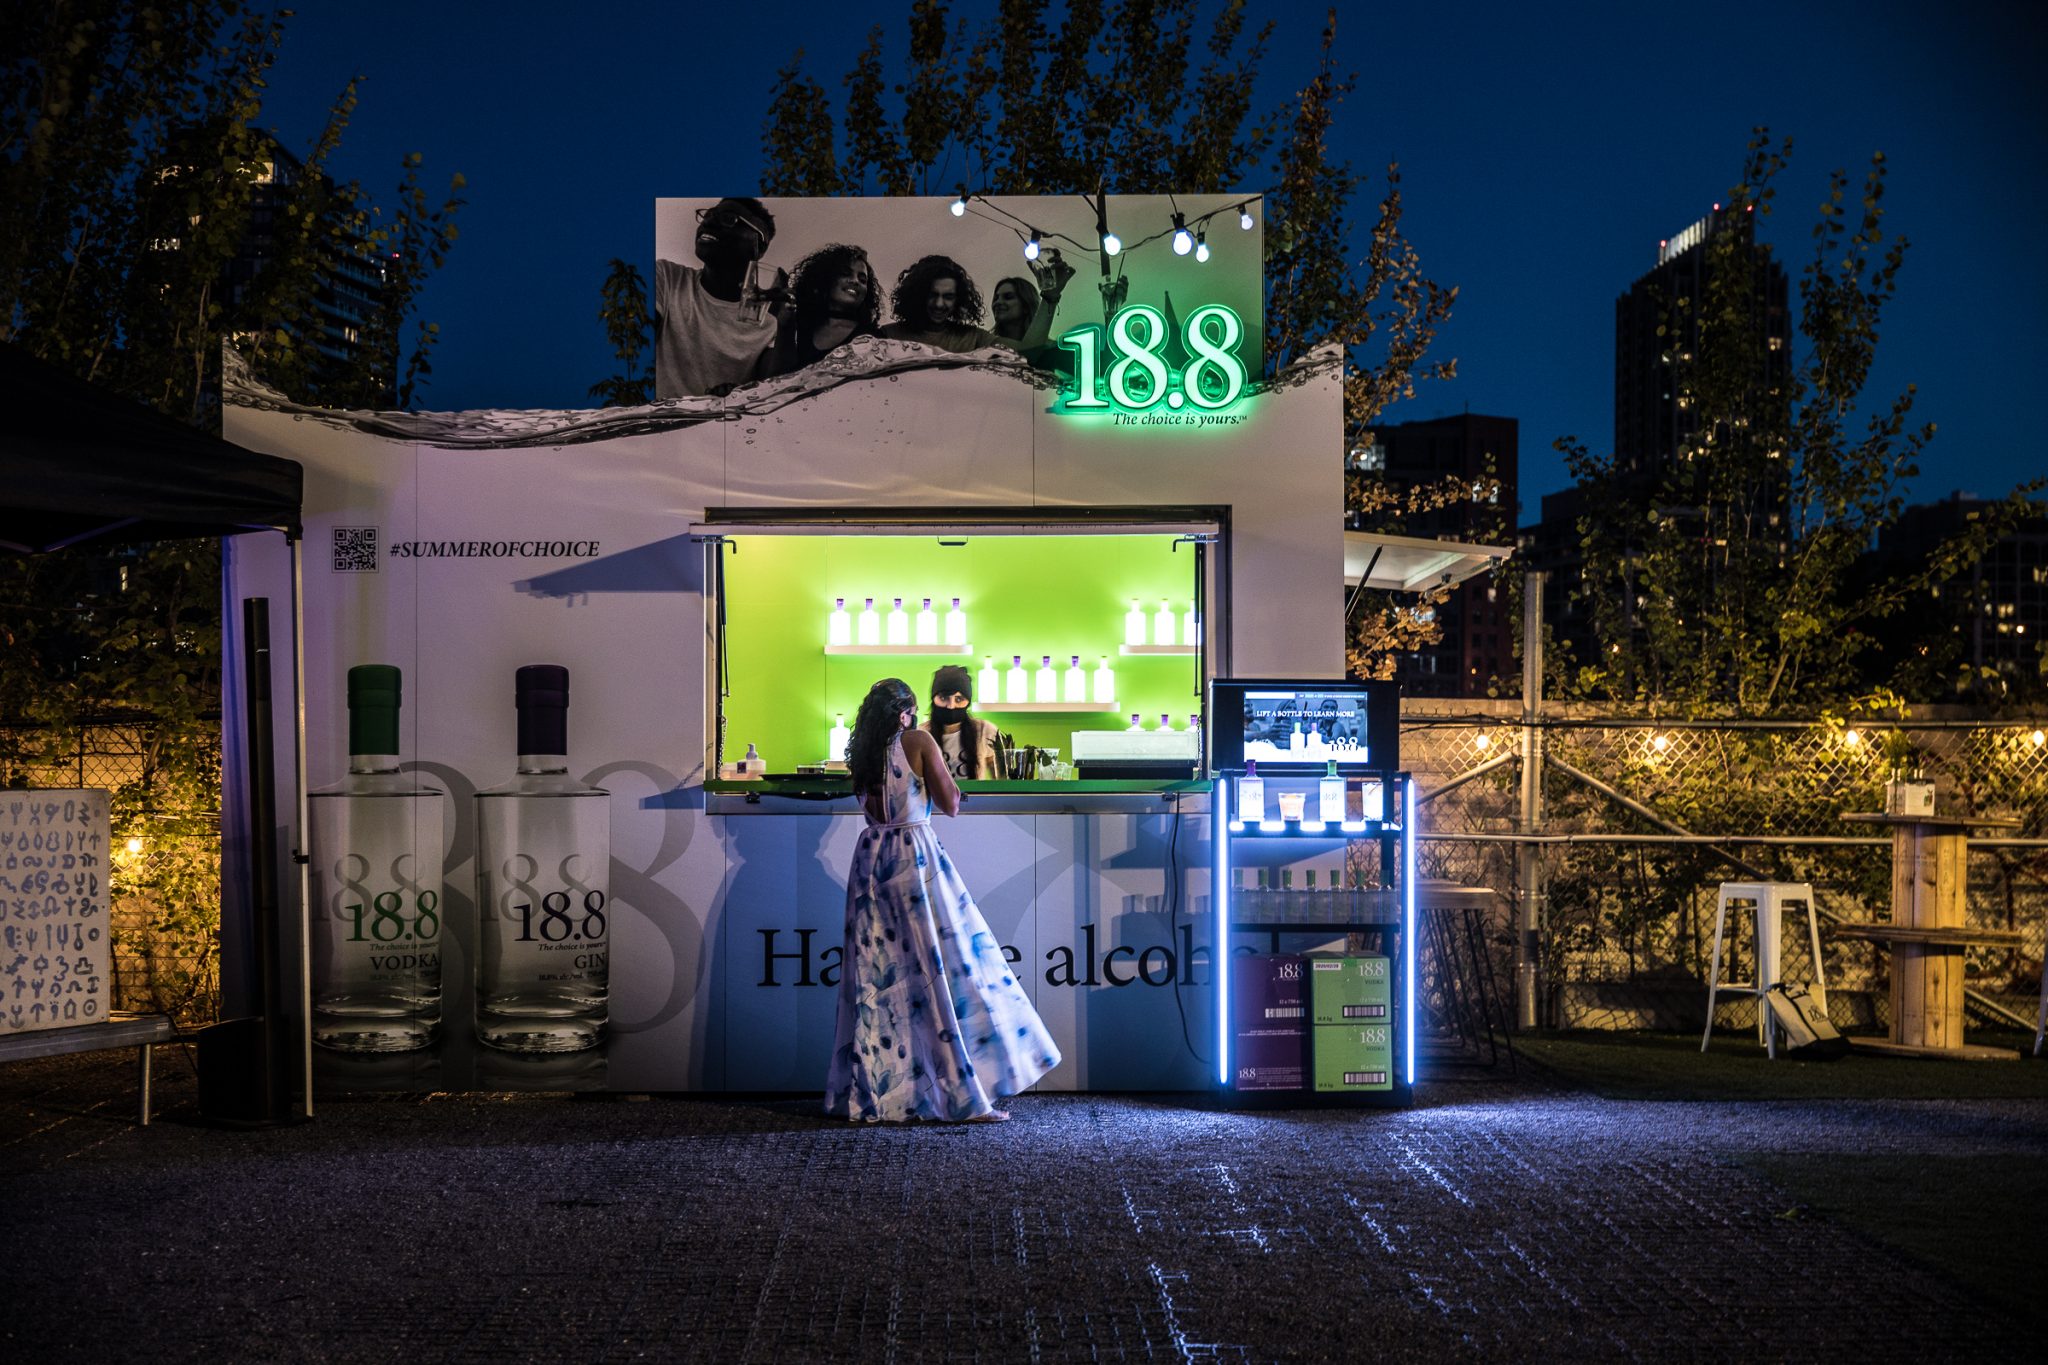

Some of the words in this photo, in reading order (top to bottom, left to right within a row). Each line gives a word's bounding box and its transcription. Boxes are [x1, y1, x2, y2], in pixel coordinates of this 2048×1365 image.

[1058, 304, 1247, 413] 18.8
[1113, 413, 1137, 425] The
[1141, 413, 1181, 425] choice
[1185, 413, 1196, 425] is
[390, 540, 600, 558] #SUMMEROFCHOICE
[345, 890, 439, 942] 18.8
[513, 890, 606, 942] 18.8
[370, 943, 384, 951] The
[386, 943, 409, 951] choice
[539, 943, 553, 951] The
[555, 943, 578, 951] choice
[1045, 924, 1280, 987] alcoh
[370, 953, 439, 970] VODKA
[575, 952, 605, 969] GIN
[756, 928, 843, 987] Ha
[1279, 963, 1304, 978] 18.8
[1359, 961, 1384, 977] 18.8
[1360, 1028, 1385, 1043] 18.8
[1239, 1068, 1256, 1080] 18.8
